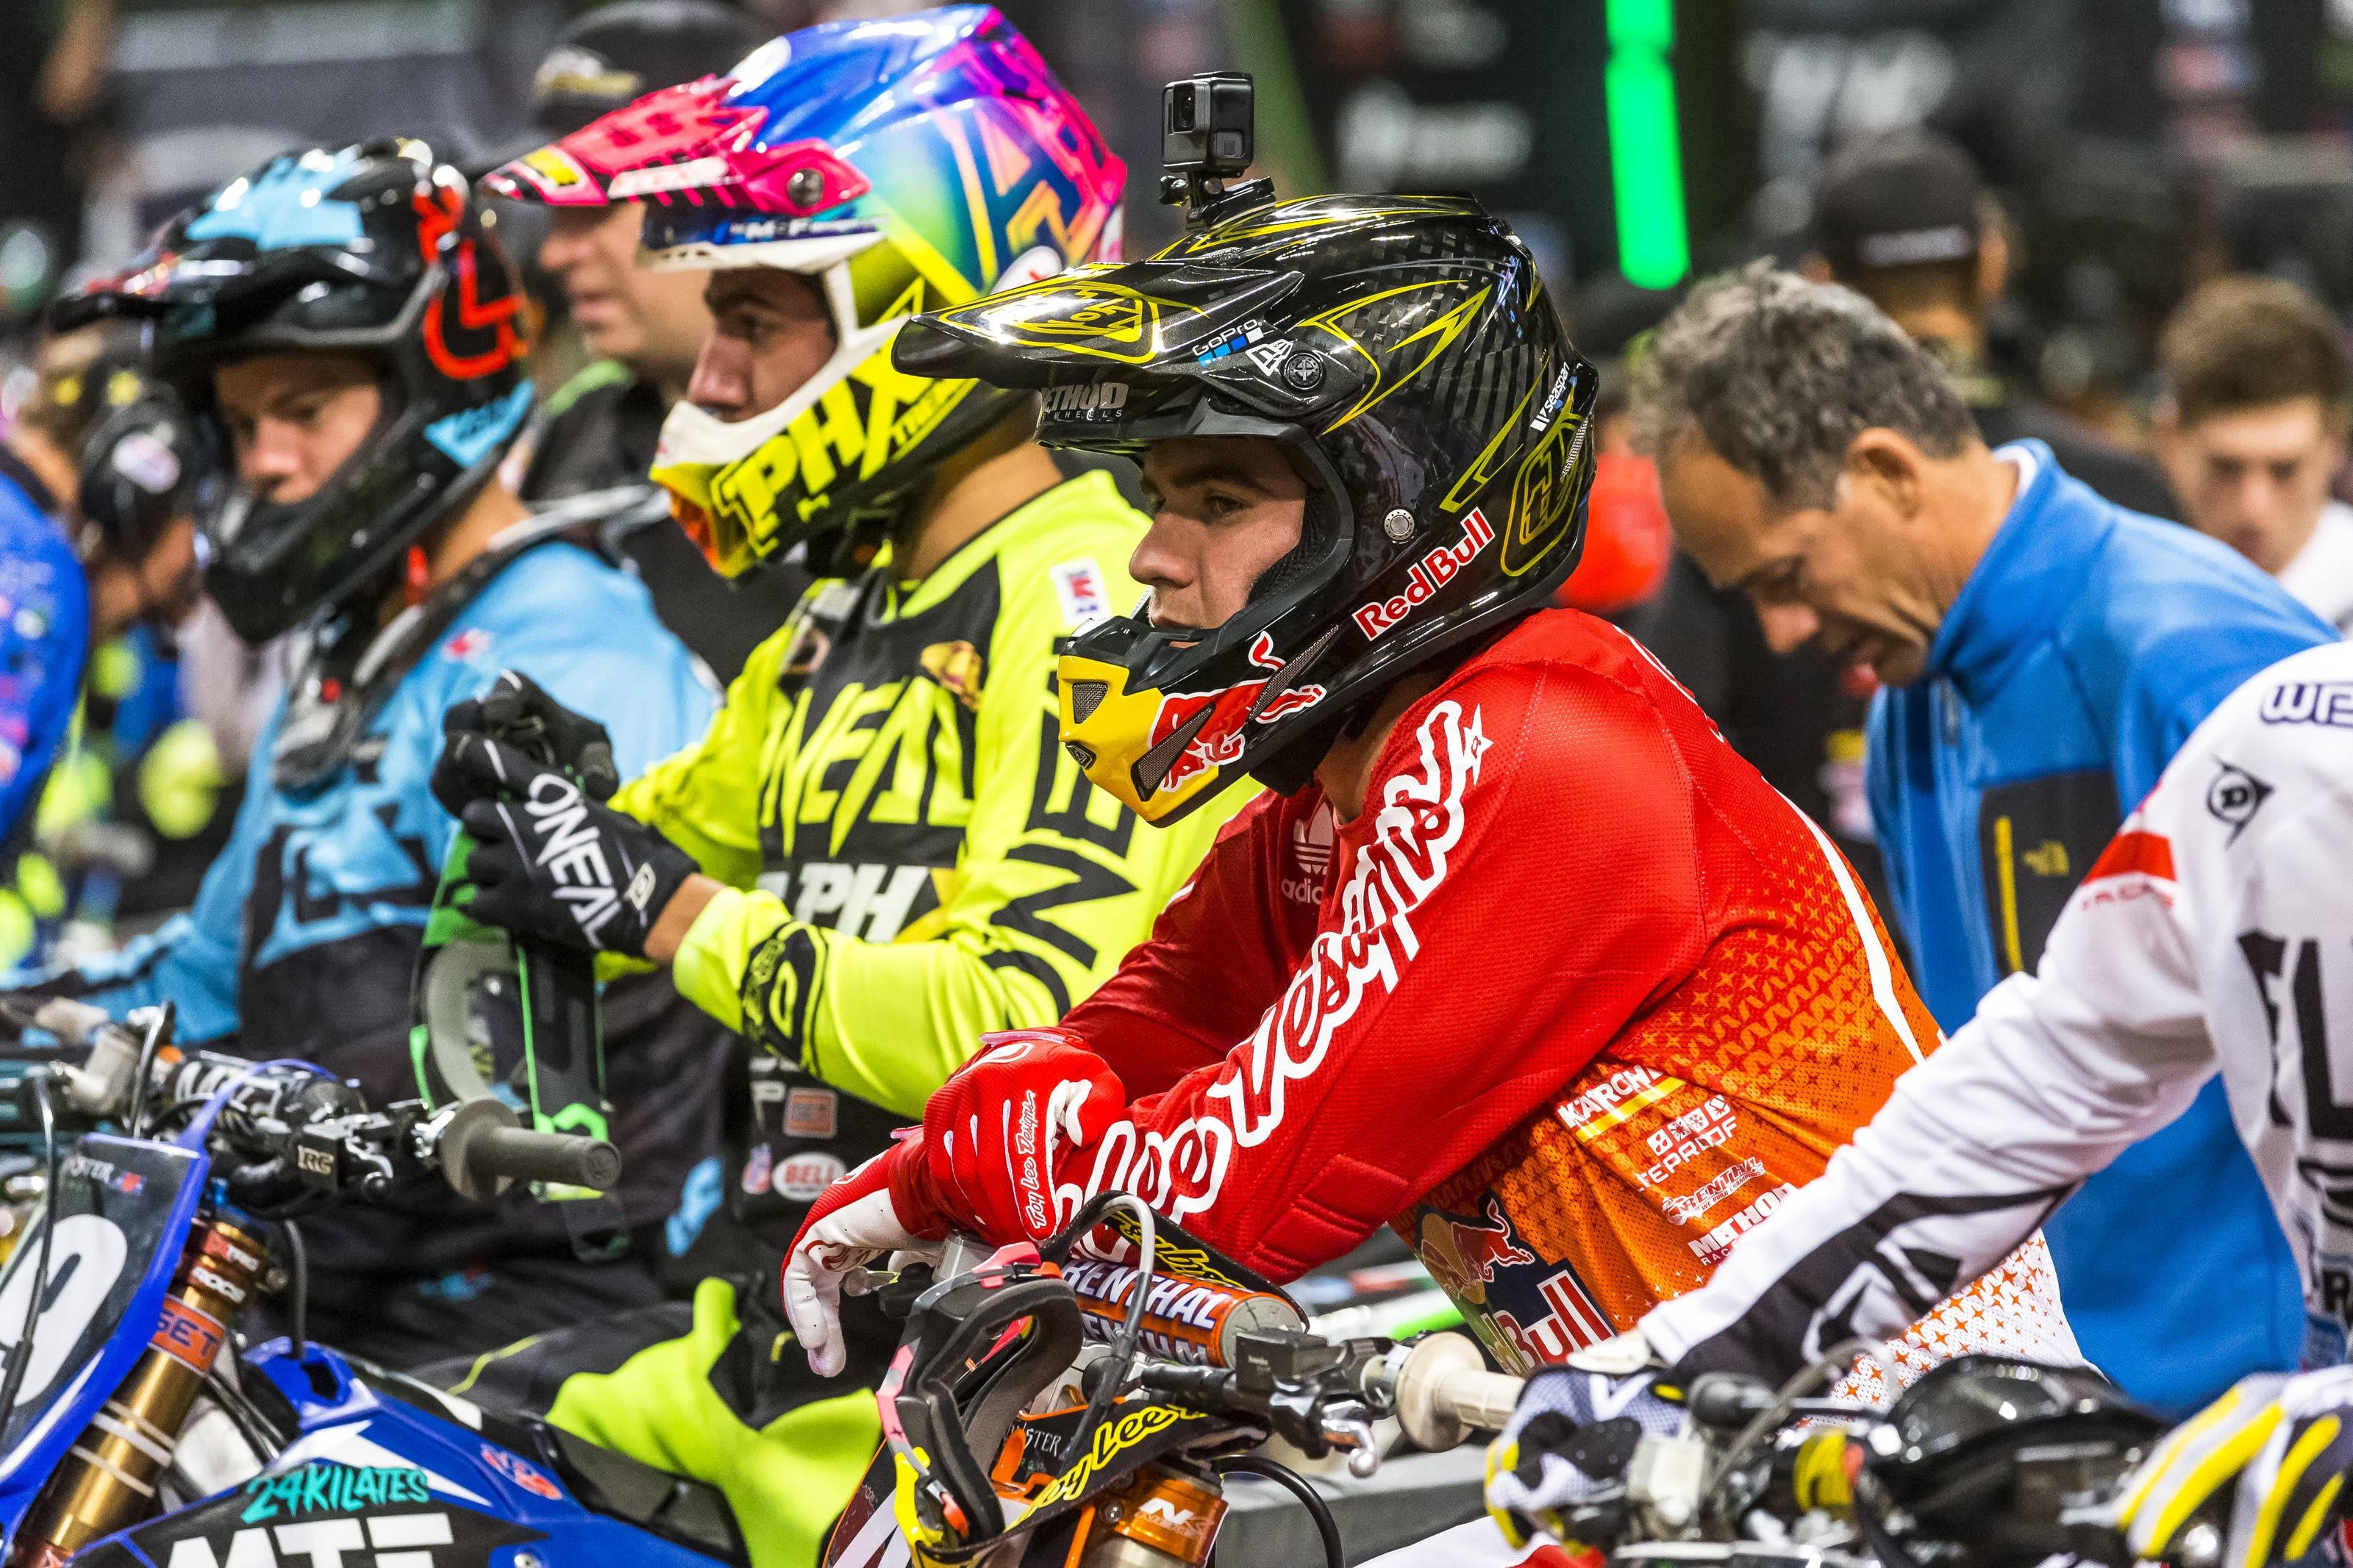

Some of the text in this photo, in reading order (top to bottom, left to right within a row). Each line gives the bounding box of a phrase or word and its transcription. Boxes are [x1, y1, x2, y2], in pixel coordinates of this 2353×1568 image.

[1192, 319, 1263, 357] GoPro
[1544, 361, 1570, 413] seaspan
[1352, 506, 1496, 641] Red Bull
[1015, 1089, 1047, 1230] Troy Lee Designs
[1091, 1405, 1179, 1471] Lee
[241, 1464, 431, 1525] 24KILATES
